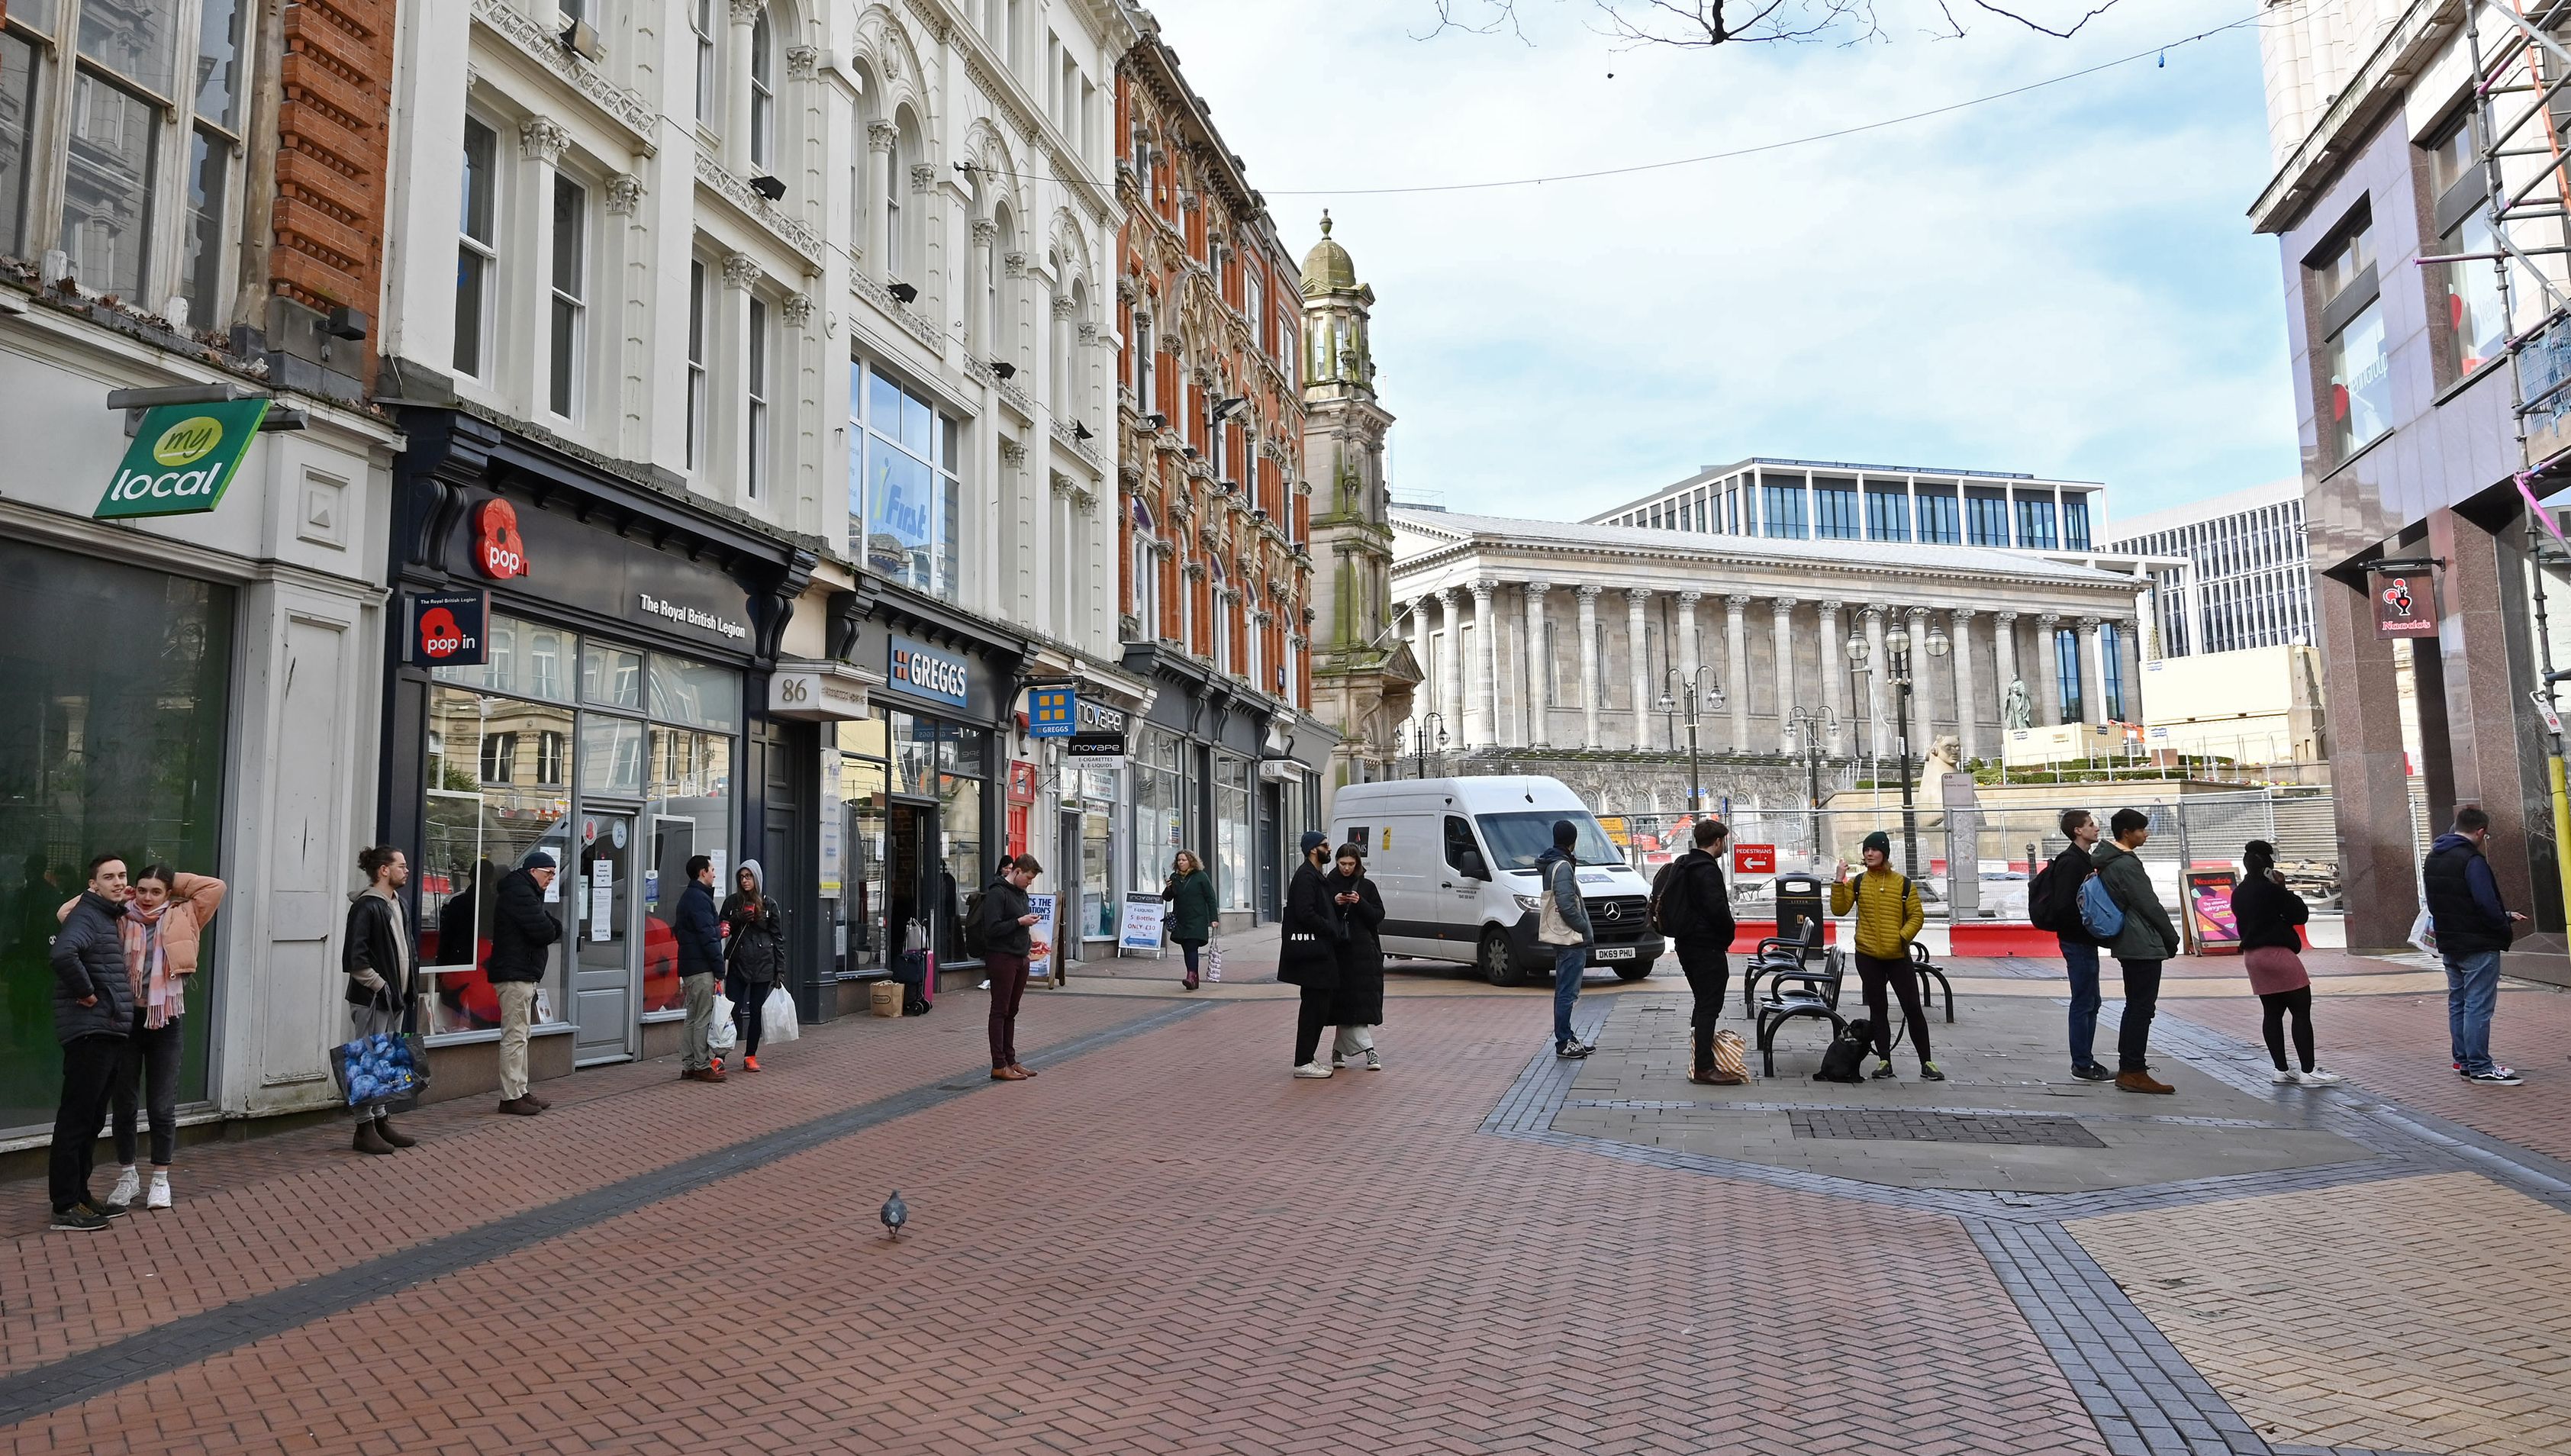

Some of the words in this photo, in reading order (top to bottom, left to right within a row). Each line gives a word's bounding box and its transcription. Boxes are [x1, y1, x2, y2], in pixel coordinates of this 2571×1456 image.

[163, 427, 213, 458] my
[111, 462, 223, 501] local
[885, 484, 926, 540] First
[489, 546, 520, 574] pop
[640, 593, 659, 614] The
[659, 600, 686, 622] Royal
[688, 608, 717, 631] British
[717, 617, 746, 638] Legion
[2382, 619, 2431, 630] Nando's
[427, 638, 458, 653] pop
[462, 634, 475, 649] in
[911, 652, 965, 697] GREGGS
[782, 678, 807, 701] 86
[1265, 763, 1274, 775] 81
[1039, 898, 1052, 907] THE
[1599, 950, 1618, 958] DK69
